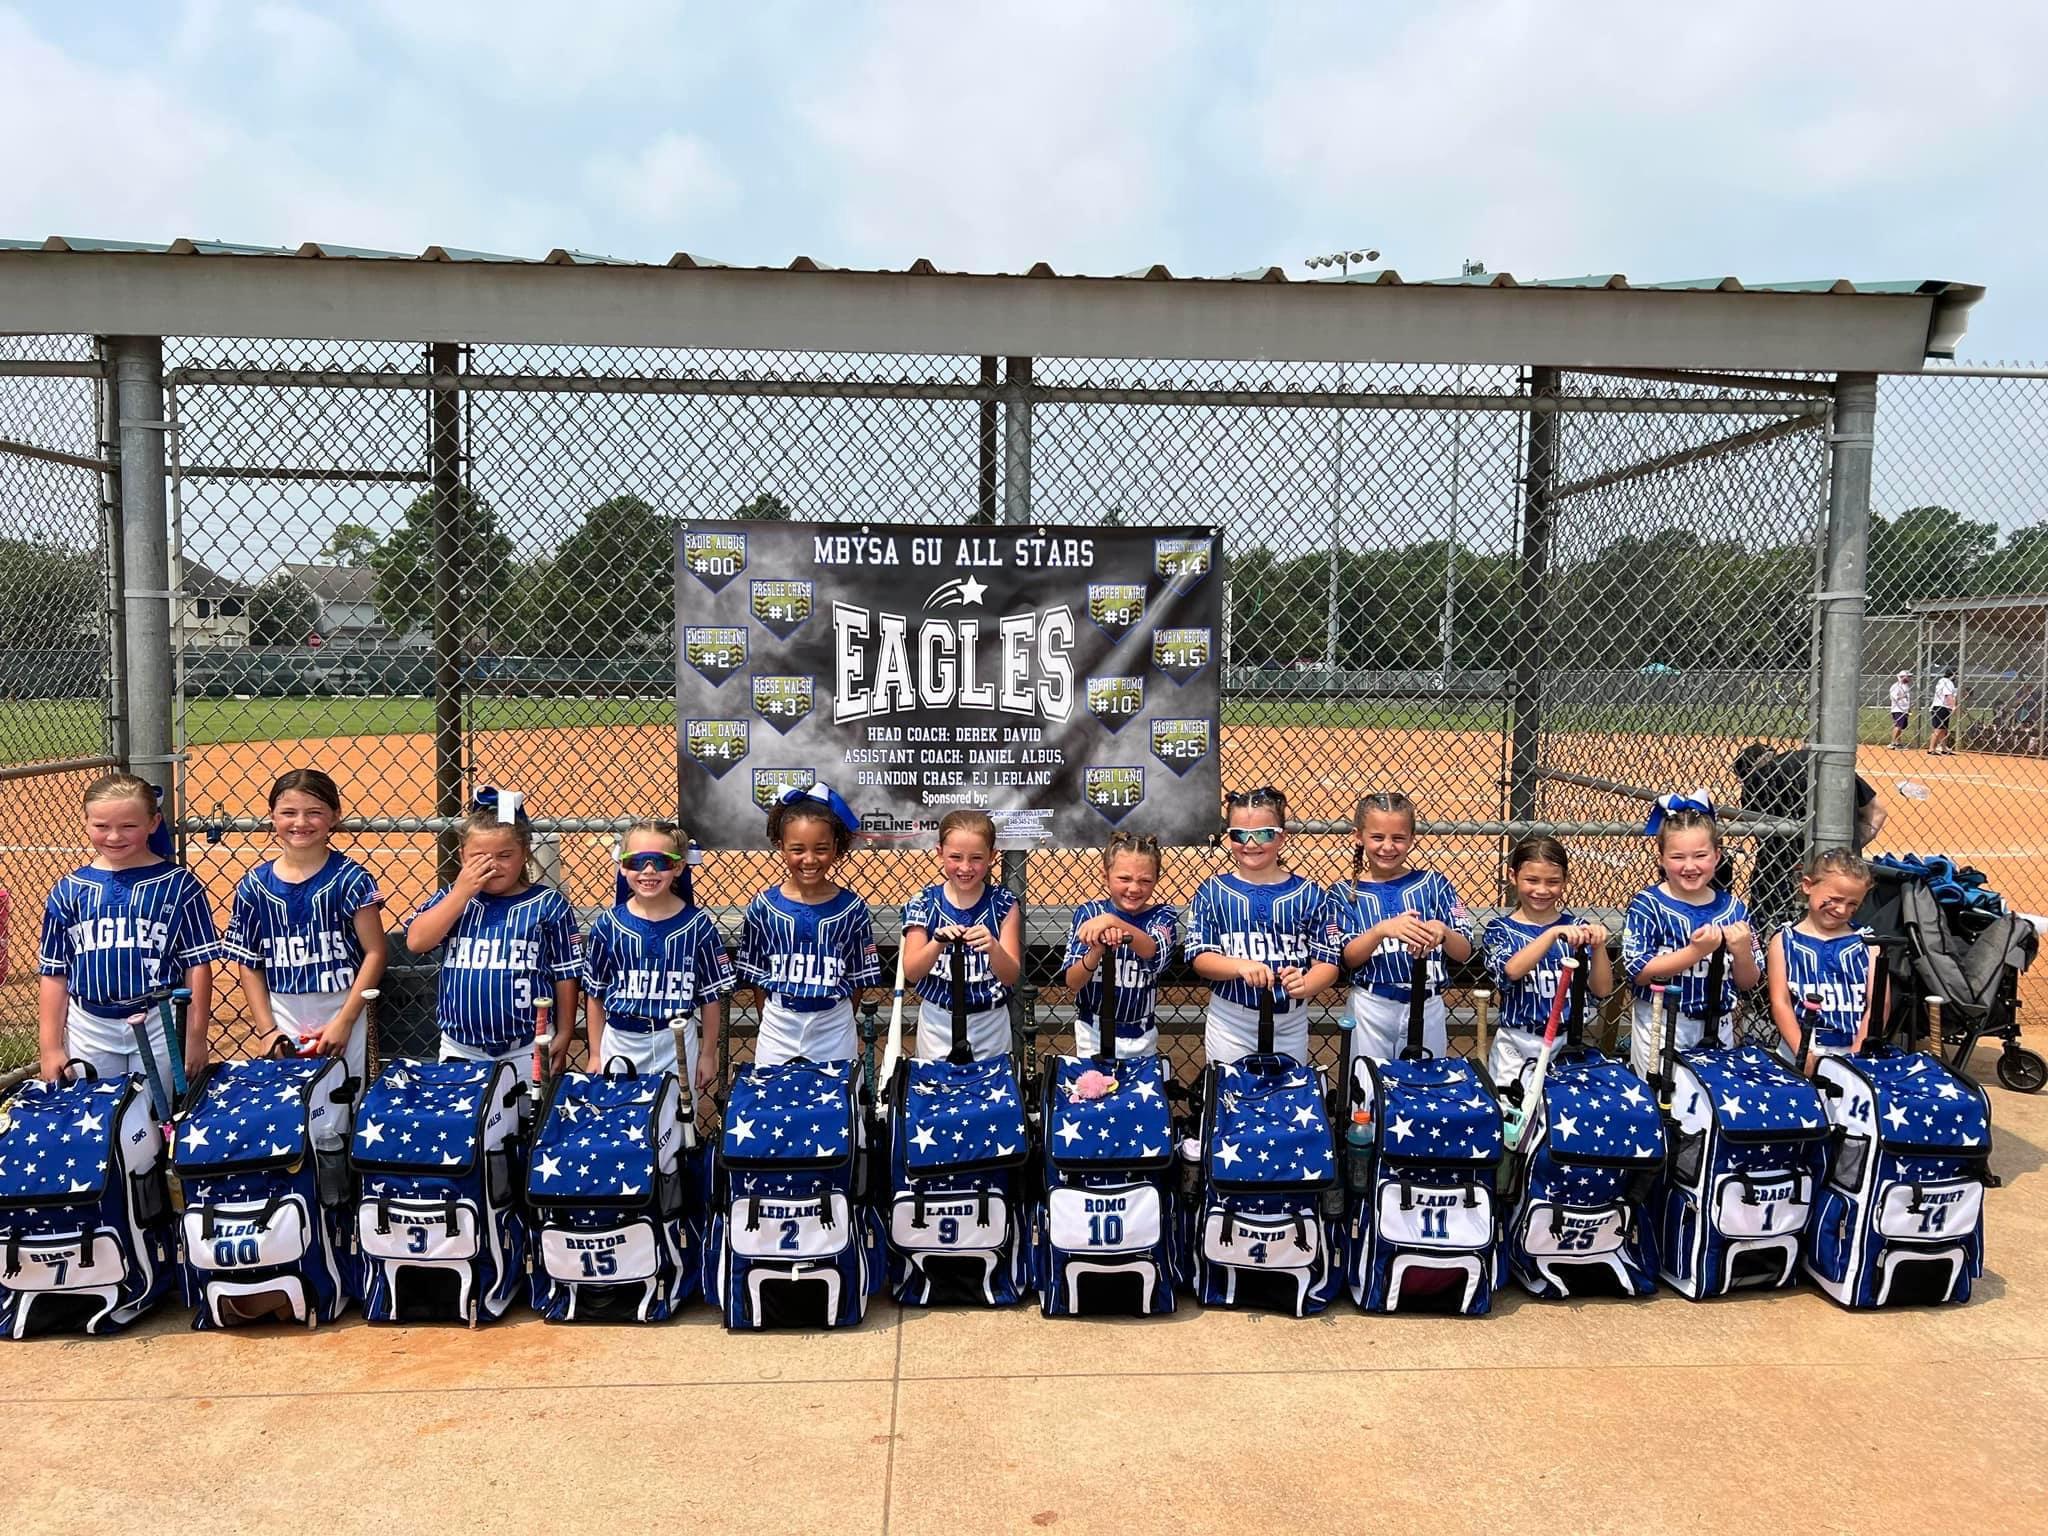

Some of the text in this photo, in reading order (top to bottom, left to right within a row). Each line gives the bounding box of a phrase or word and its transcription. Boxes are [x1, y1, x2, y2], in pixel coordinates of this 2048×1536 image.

[685, 535, 745, 549] SADIE ALBUS
[814, 536, 1094, 567] MBYSA 6U ALL STARS
[694, 557, 735, 575] #00
[1165, 559, 1201, 576] #14
[753, 583, 812, 597] PRESLEE CRASE
[1089, 586, 1145, 600] HARPER LAIRD
[768, 603, 794, 622] #1
[1104, 607, 1130, 626] #9
[687, 630, 713, 645] EMERIE
[702, 649, 729, 668] #2
[832, 600, 1075, 724] EAGLES
[1162, 648, 1201, 667] #15
[754, 680, 812, 694] REESE WALSH
[1087, 678, 1143, 691] SOPHIE ROMO
[769, 697, 796, 716] #3
[1095, 695, 1132, 714] #10
[689, 723, 746, 737] DAHL DAVID
[868, 727, 1041, 742] HEAD COACH: DEREK DAVID
[703, 741, 730, 759] #4
[845, 749, 1065, 765] ASSISTANT COACH: DANIEL ALBUS,
[1160, 739, 1199, 758] #25
[755, 772, 812, 786] PAISLEY SIMS
[858, 771, 1051, 787] BRANDON CRASE, EJ LEBLANC
[1085, 770, 1142, 783] KAPRI LAND
[922, 790, 988, 807] Sponsored by:
[1096, 789, 1132, 806] #11
[919, 820, 940, 831] MD
[68, 917, 168, 955] EAGLES
[262, 930, 348, 968] EAGLES
[444, 936, 540, 970] EAGLES
[1221, 931, 1309, 961] EAGLES
[864, 953, 880, 965] 20
[142, 957, 162, 987] 7
[768, 952, 847, 987] EAGLES
[514, 977, 532, 1009] 3
[614, 969, 696, 1001] EAGLES
[1686, 1091, 1700, 1116] 1
[1848, 1094, 1871, 1123] 14
[131, 1128, 147, 1145] SIMS
[1084, 1197, 1127, 1213] ROMO
[1415, 1193, 1458, 1208] LAND
[759, 1205, 823, 1219] LEBLANC
[926, 1204, 973, 1217] LAIRD
[1761, 1203, 1775, 1231] 1
[1918, 1205, 1948, 1233] 14
[937, 1217, 960, 1245] 9
[1087, 1215, 1124, 1246] 10
[1421, 1207, 1449, 1240] 11
[407, 1226, 428, 1254] 3
[565, 1234, 627, 1250] RECTOR
[779, 1219, 800, 1251] 2
[1238, 1227, 1286, 1242] DAVID
[1557, 1227, 1599, 1251] 25
[30, 1250, 76, 1263] SIMS
[213, 1238, 261, 1268] 00
[1247, 1242, 1269, 1264] 4
[580, 1248, 619, 1278] 15
[45, 1259, 69, 1287] 7
